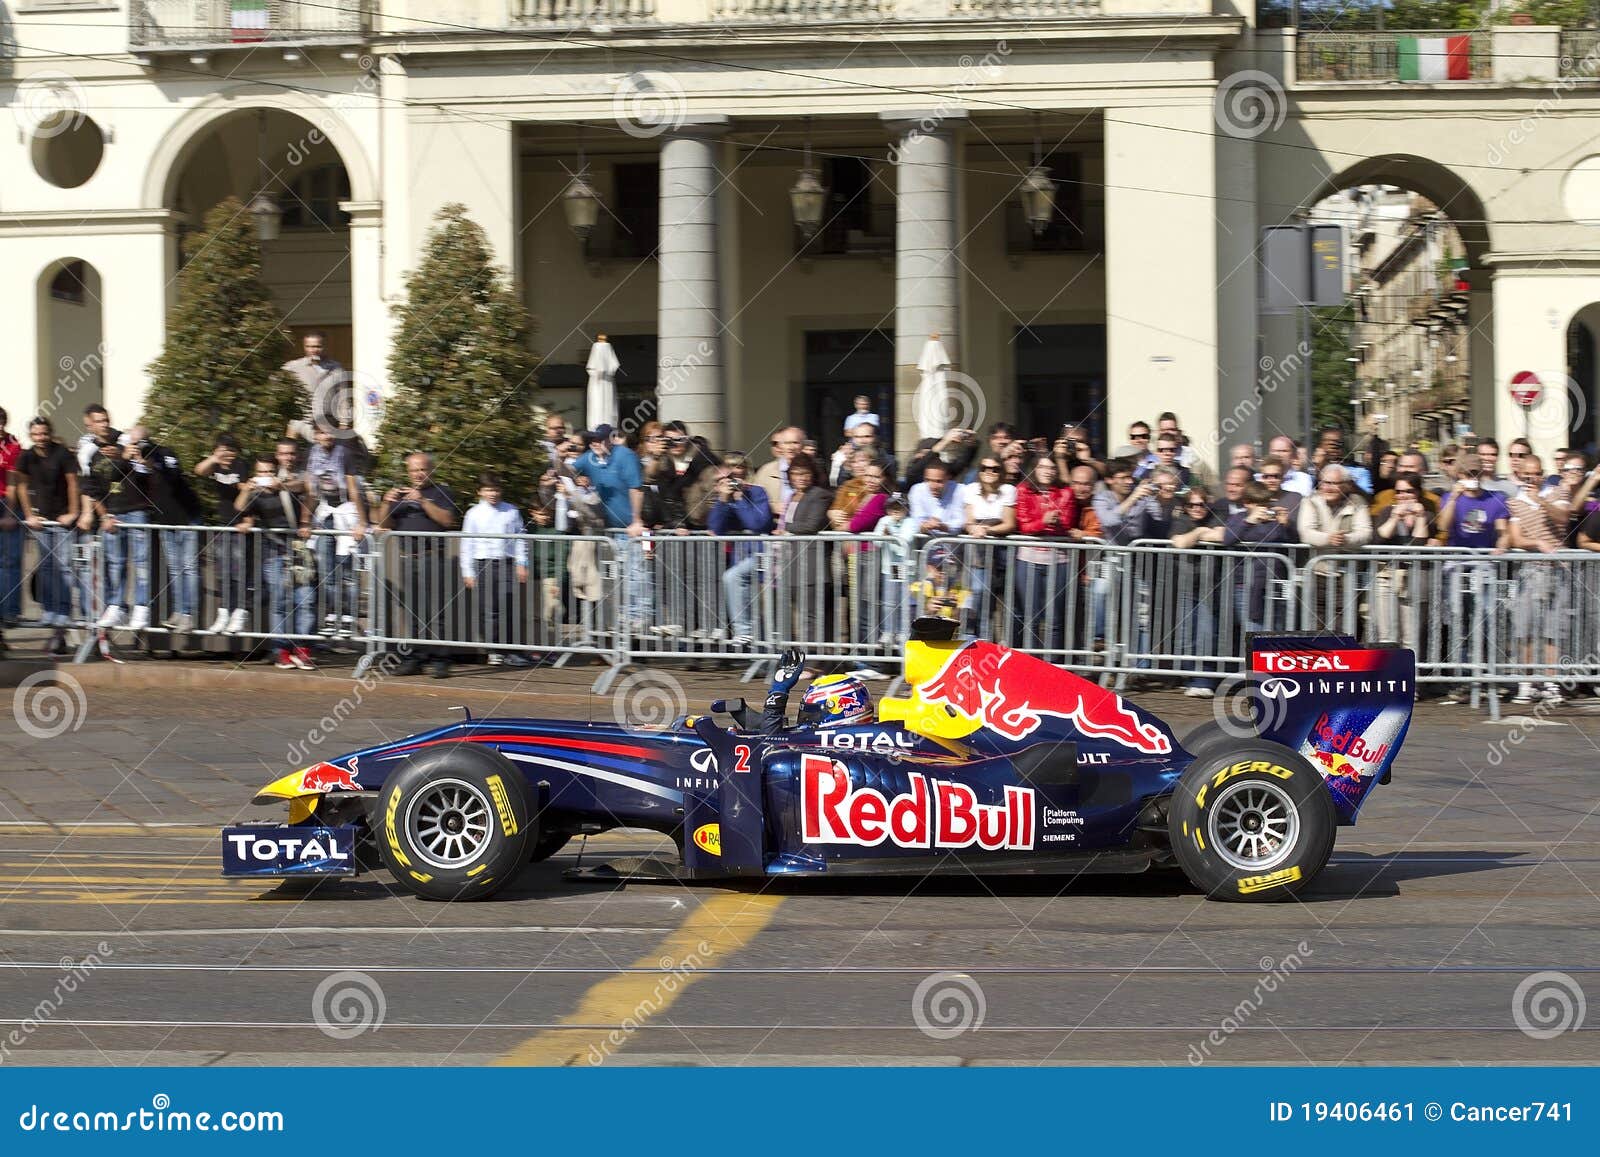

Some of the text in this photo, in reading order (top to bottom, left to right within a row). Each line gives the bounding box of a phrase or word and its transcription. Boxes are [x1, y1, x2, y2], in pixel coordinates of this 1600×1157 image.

[1259, 652, 1350, 671] TOTAL
[1309, 680, 1407, 694] INFINITI
[815, 729, 914, 751] TOTAL
[1315, 711, 1389, 764] Red Bull
[735, 744, 751, 773] 2
[1211, 760, 1295, 788] ZERO
[801, 753, 1036, 850] Red Bull
[1047, 809, 1077, 817] Platform
[385, 784, 412, 868] ZERO
[1047, 816, 1084, 826] Computing
[228, 834, 348, 861] TOTAL
[1042, 834, 1076, 842] SIEMENS
